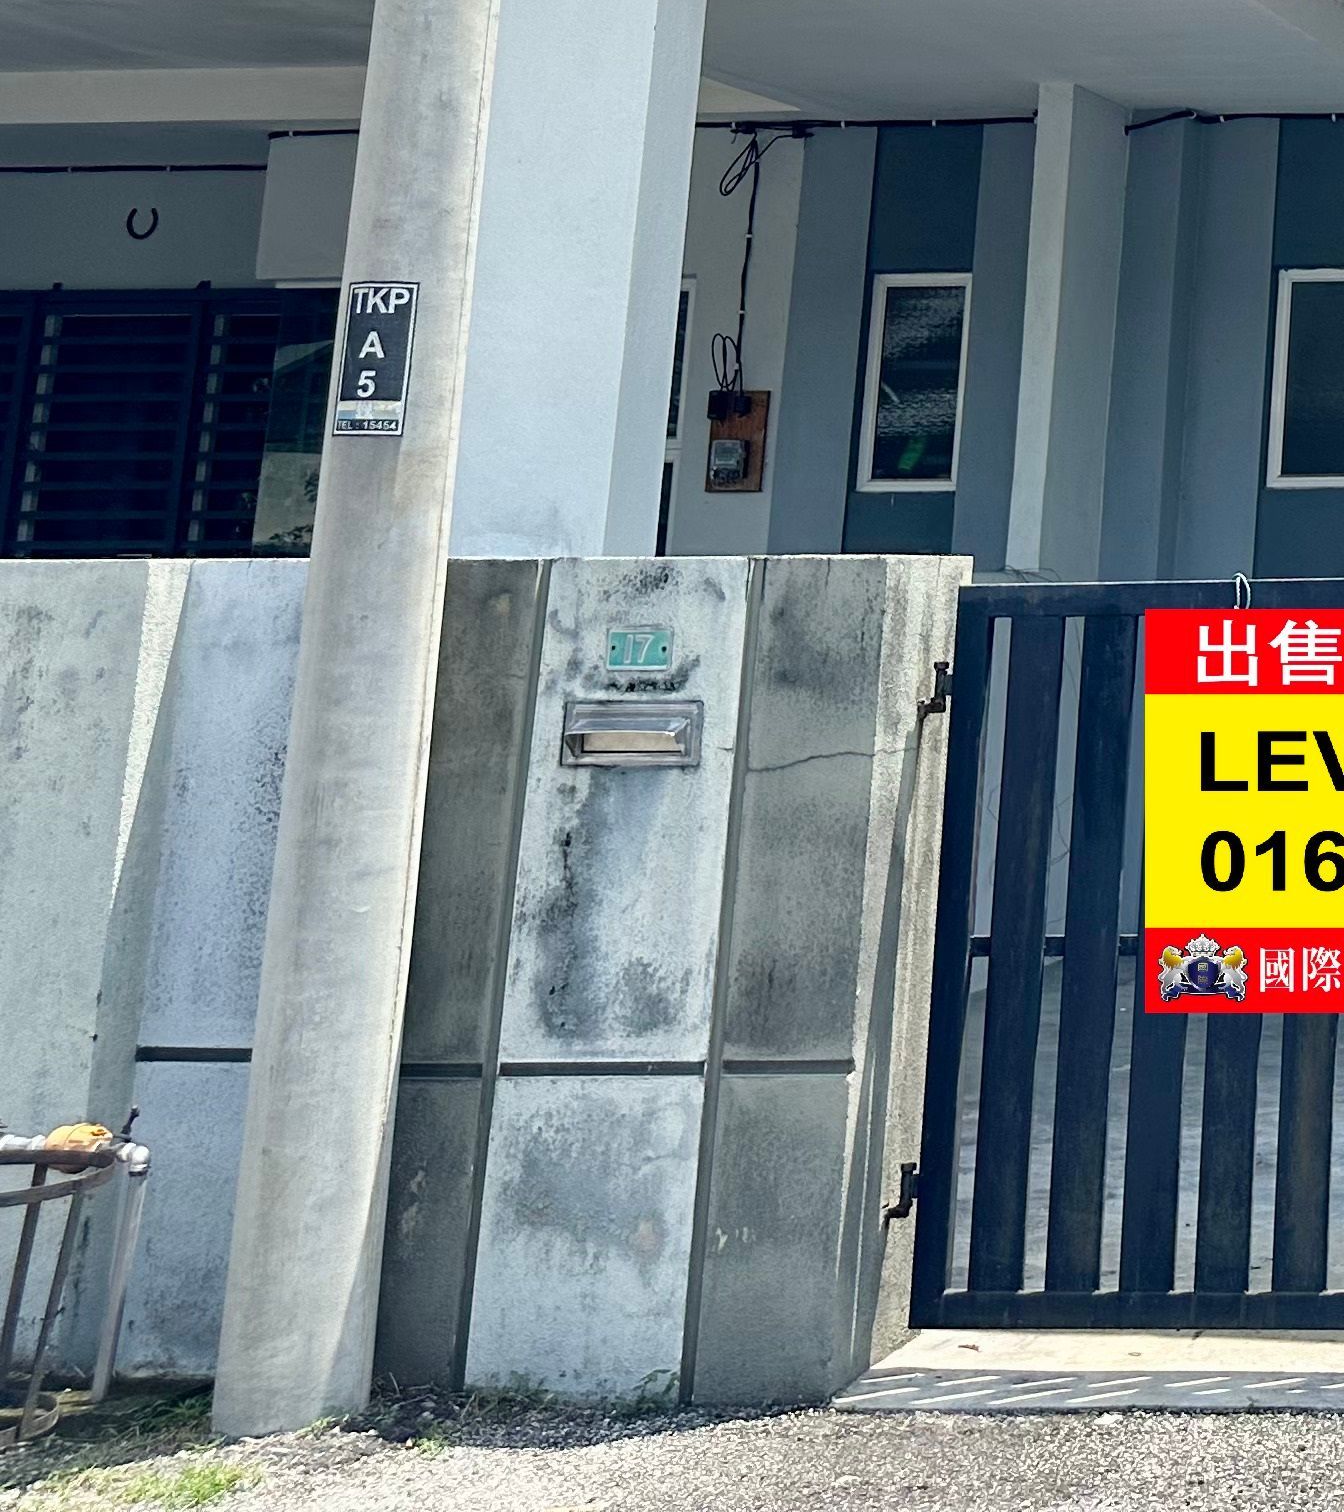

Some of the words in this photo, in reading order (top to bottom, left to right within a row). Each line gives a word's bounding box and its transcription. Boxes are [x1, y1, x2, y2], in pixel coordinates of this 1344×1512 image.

[354, 287, 411, 315] TKP
[358, 330, 386, 359] A
[356, 370, 377, 398] 5
[623, 634, 655, 664] 17
[1196, 619, 1343, 686] 出售
